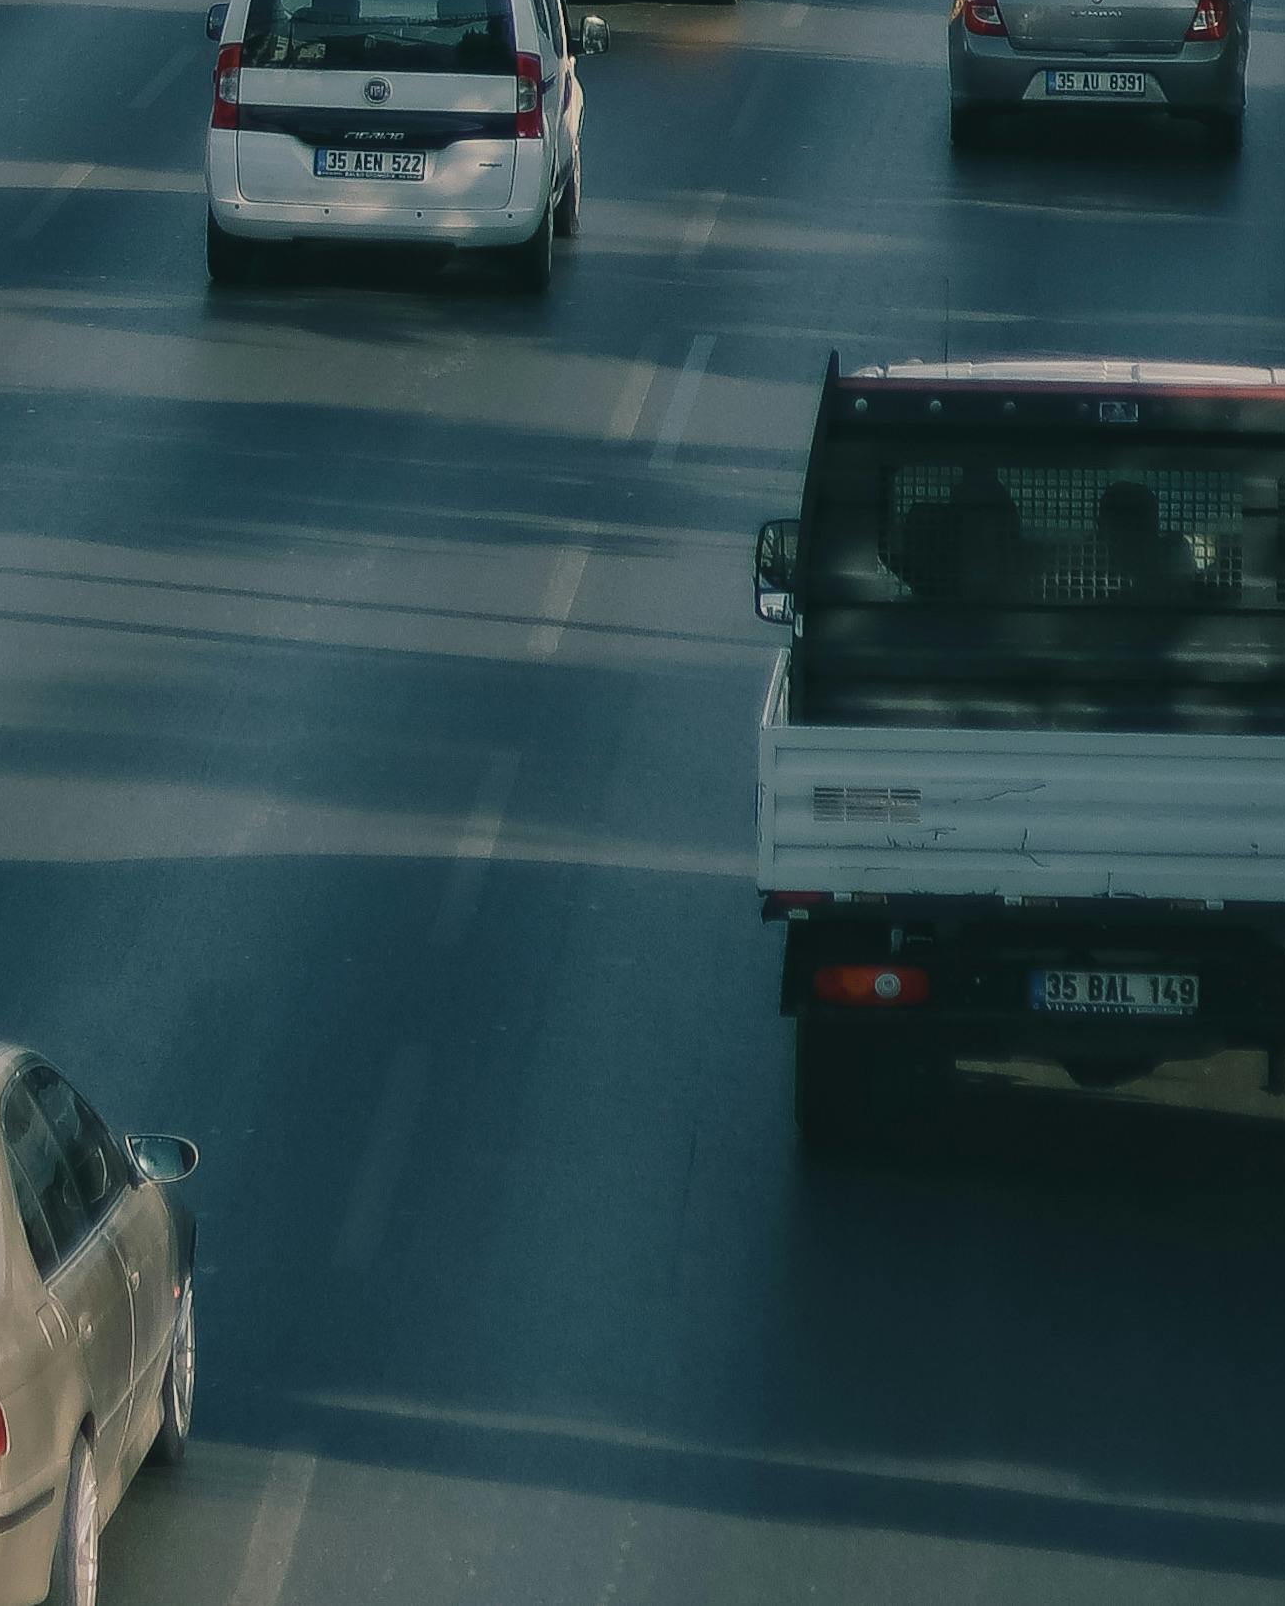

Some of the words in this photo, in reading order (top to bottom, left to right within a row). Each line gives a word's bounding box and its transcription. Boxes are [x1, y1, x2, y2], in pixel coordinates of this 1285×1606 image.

[1057, 73, 1075, 89] 35
[1082, 73, 1100, 90] AU
[1109, 74, 1143, 91] 8391
[327, 151, 348, 170] 35
[354, 152, 383, 172] AEN
[391, 154, 421, 173] 522
[1046, 972, 1078, 1001] 35
[1087, 975, 1135, 1004] BAL
[1149, 976, 1196, 1005] 149
